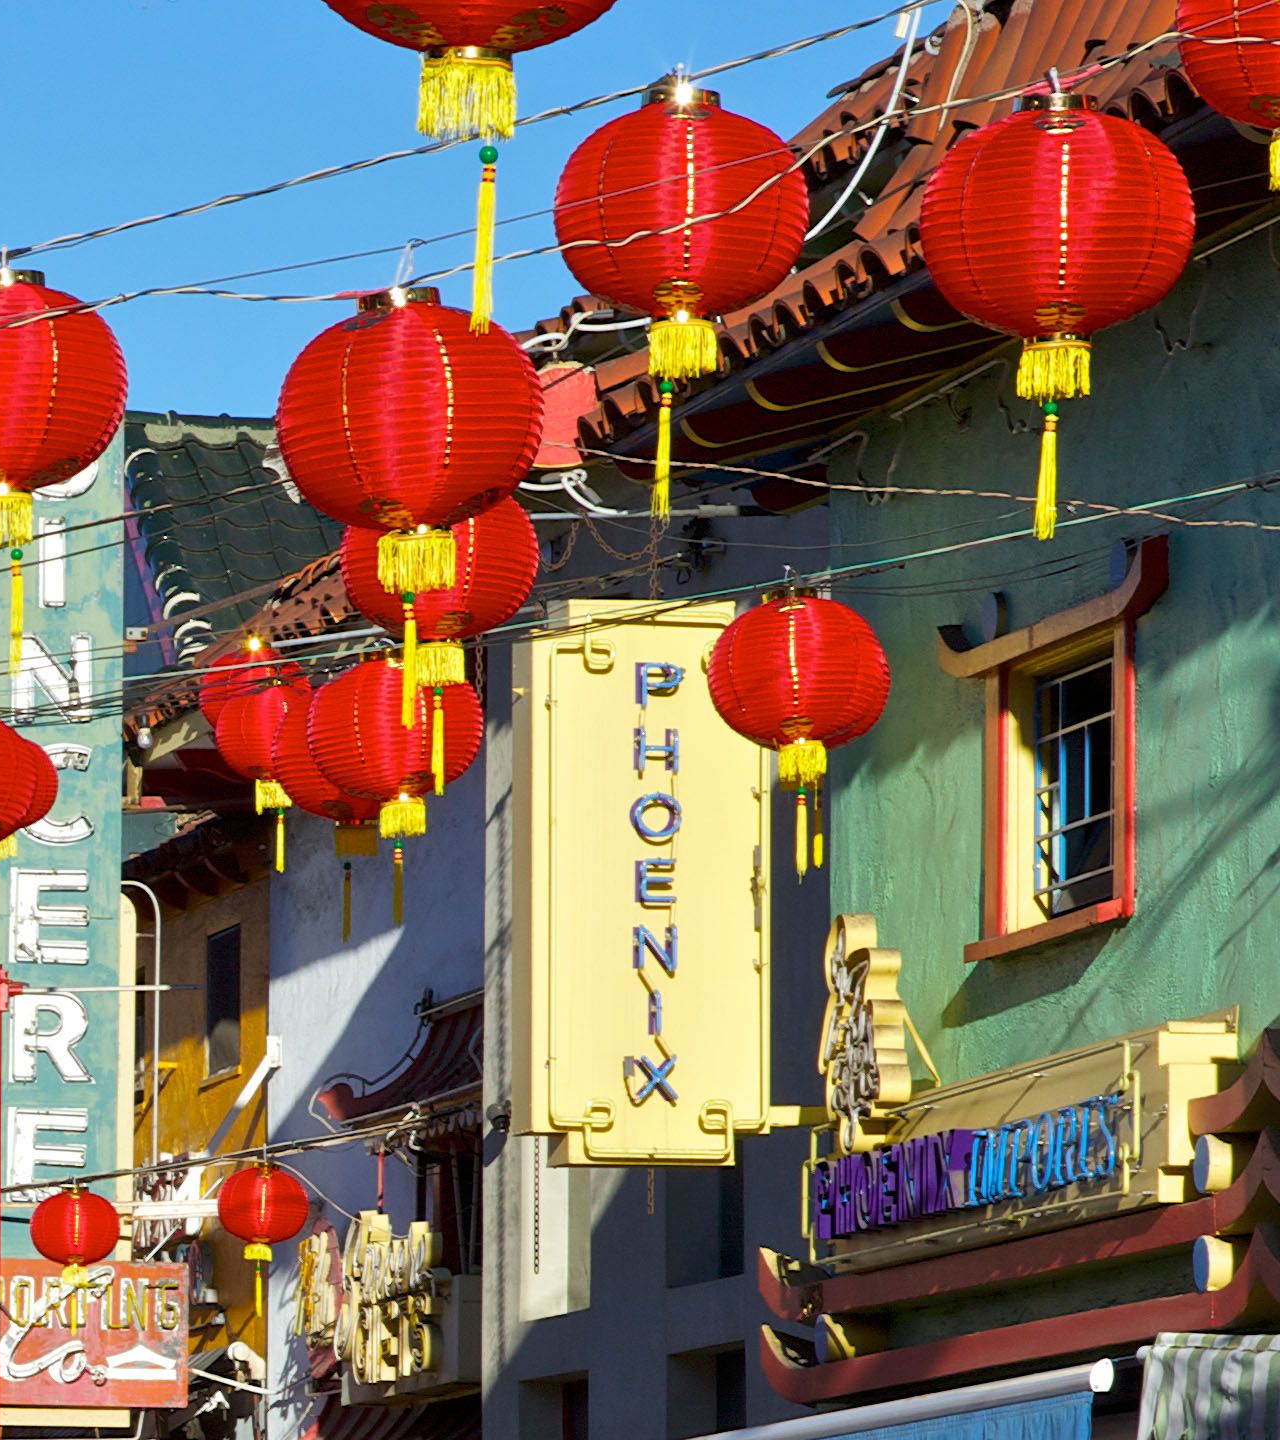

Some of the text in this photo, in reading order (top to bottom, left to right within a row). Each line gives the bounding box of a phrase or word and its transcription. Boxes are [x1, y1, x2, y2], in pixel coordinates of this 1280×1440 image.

[7, 450, 100, 1203] INCERE
[623, 661, 685, 1106] PHOENIX
[814, 1090, 1124, 1240] PHOENIX IMPORTS
